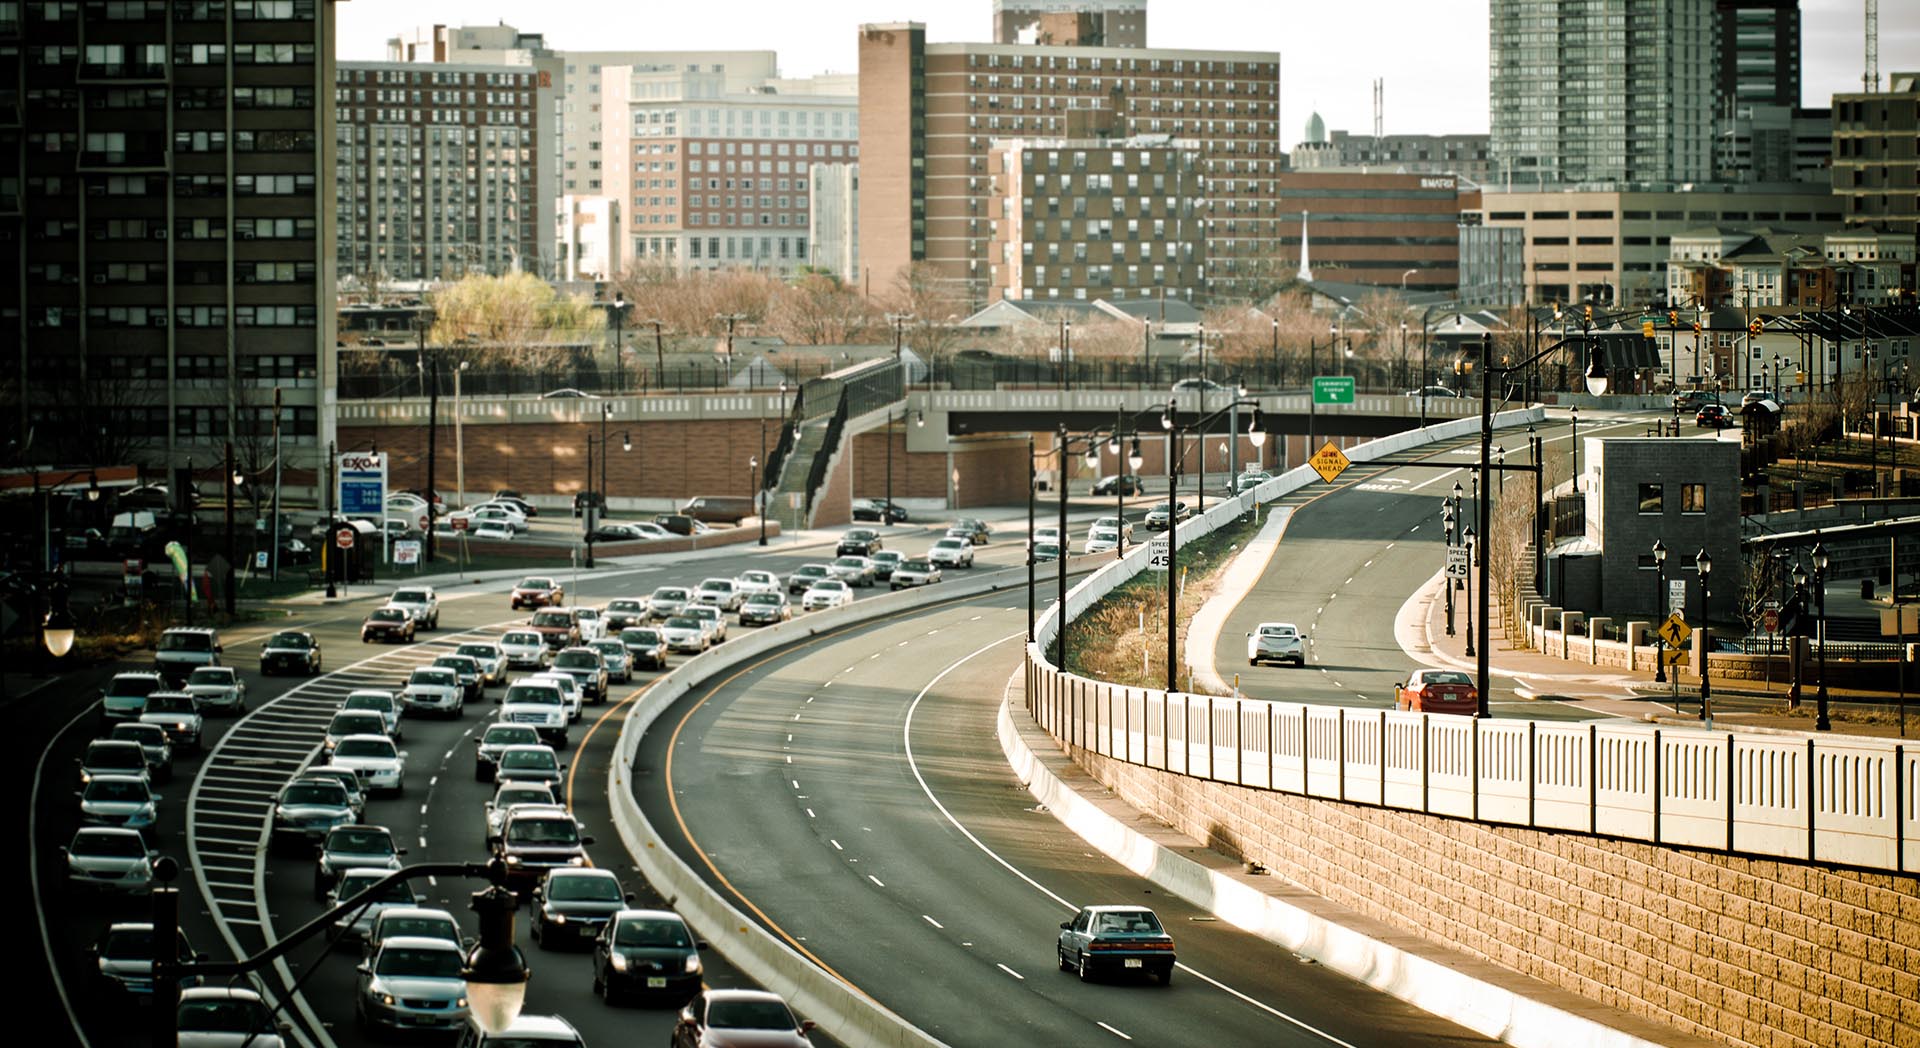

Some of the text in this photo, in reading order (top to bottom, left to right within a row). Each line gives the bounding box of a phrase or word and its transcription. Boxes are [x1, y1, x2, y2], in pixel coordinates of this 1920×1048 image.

[1150, 556, 1169, 567] 45
[1447, 564, 1467, 575] 45
[1765, 616, 1777, 626] STOP
